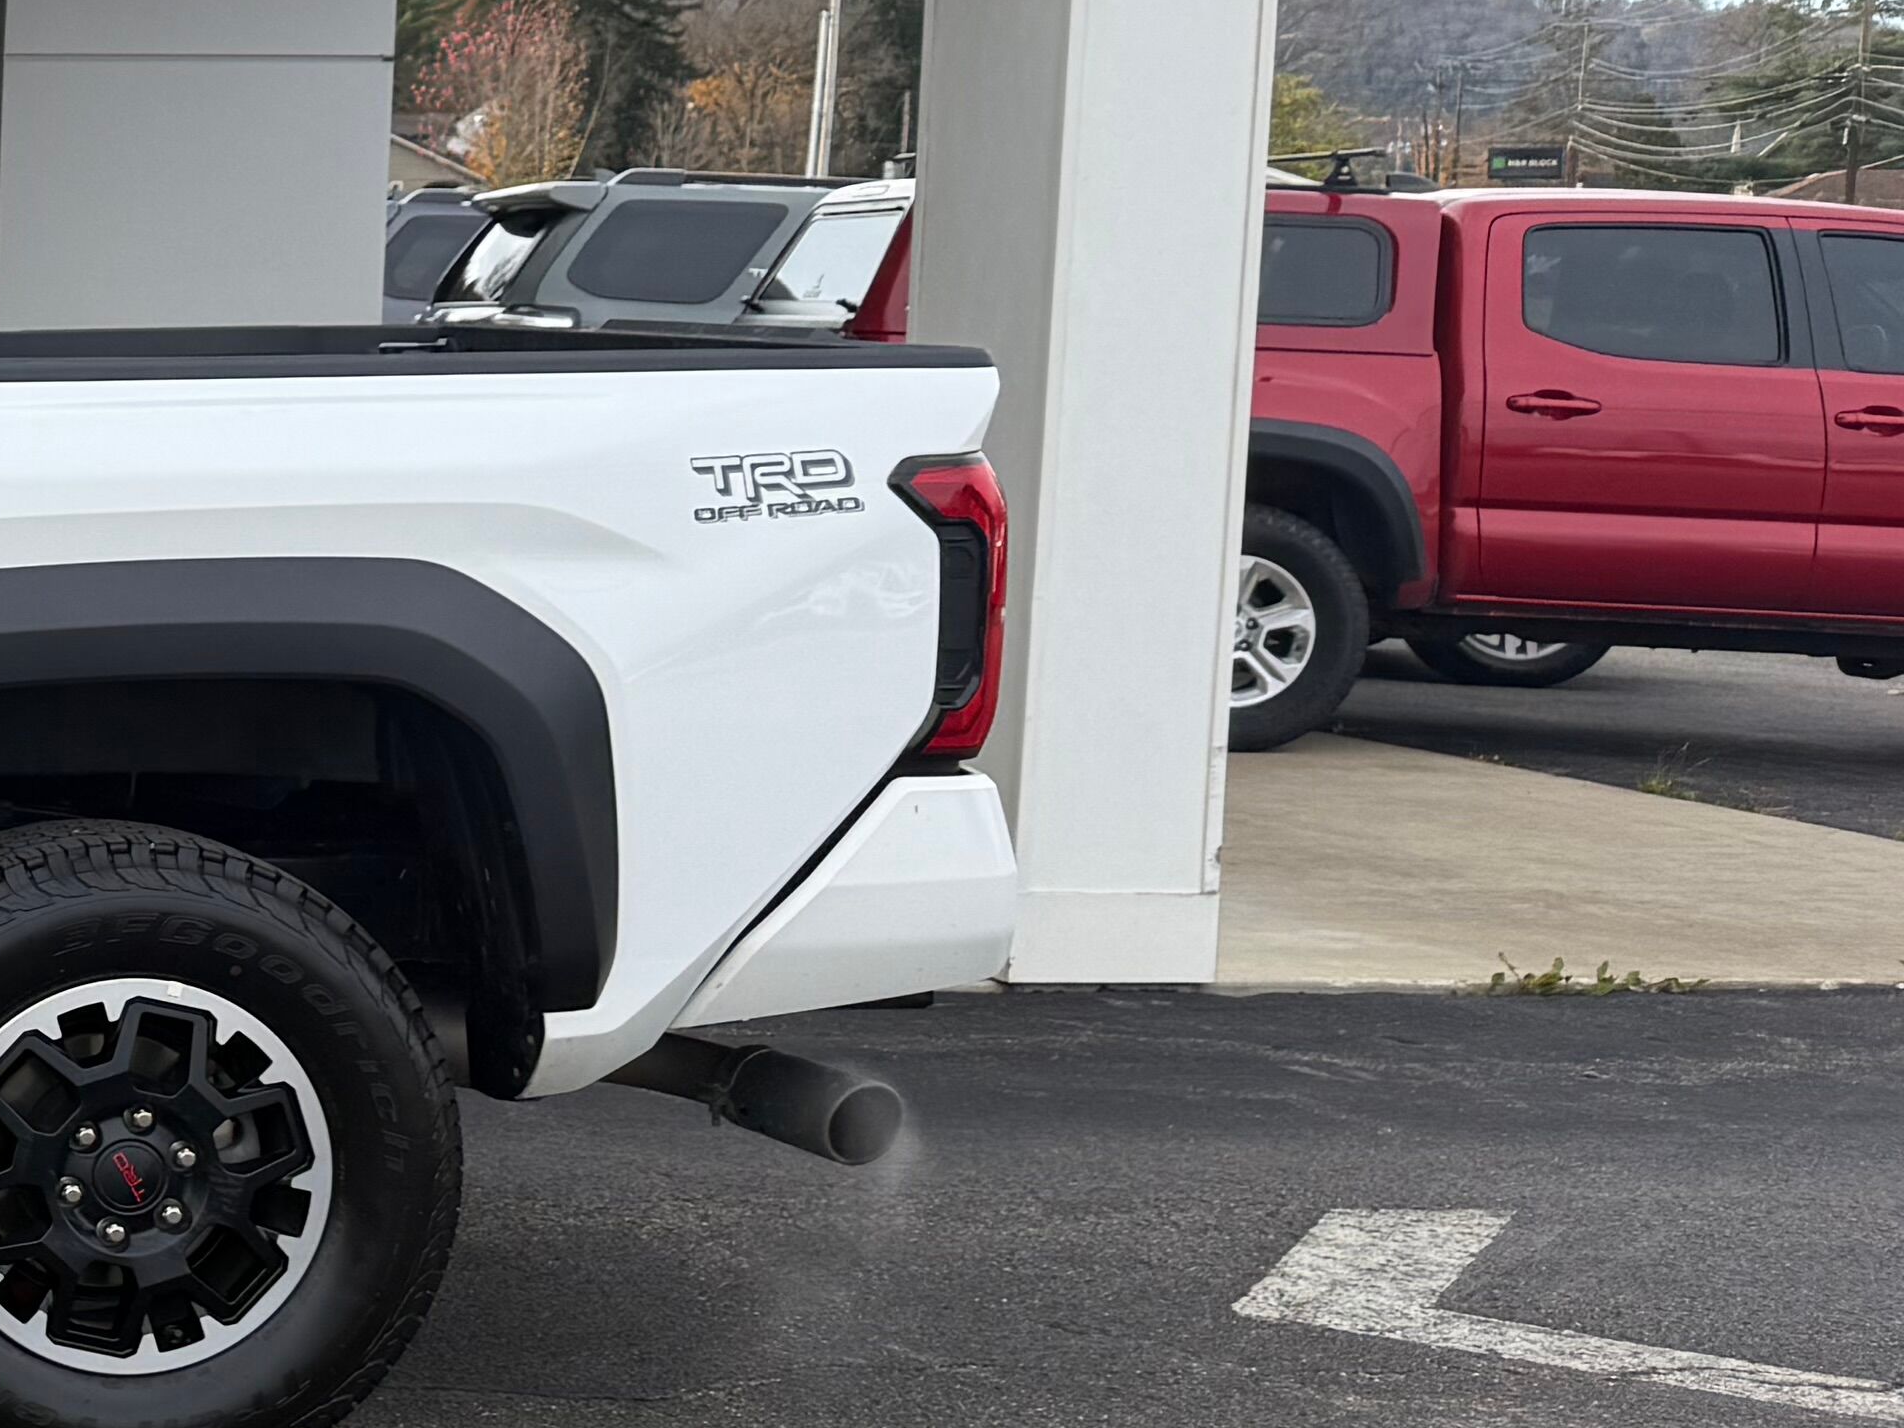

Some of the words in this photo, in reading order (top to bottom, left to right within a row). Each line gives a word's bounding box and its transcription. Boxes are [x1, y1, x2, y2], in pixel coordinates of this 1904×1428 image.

[690, 449, 856, 503] TRD
[694, 503, 762, 524] OFF
[768, 498, 865, 519] ROAD
[51, 912, 414, 1173] BFGoodrich
[111, 1150, 146, 1206] TRD
